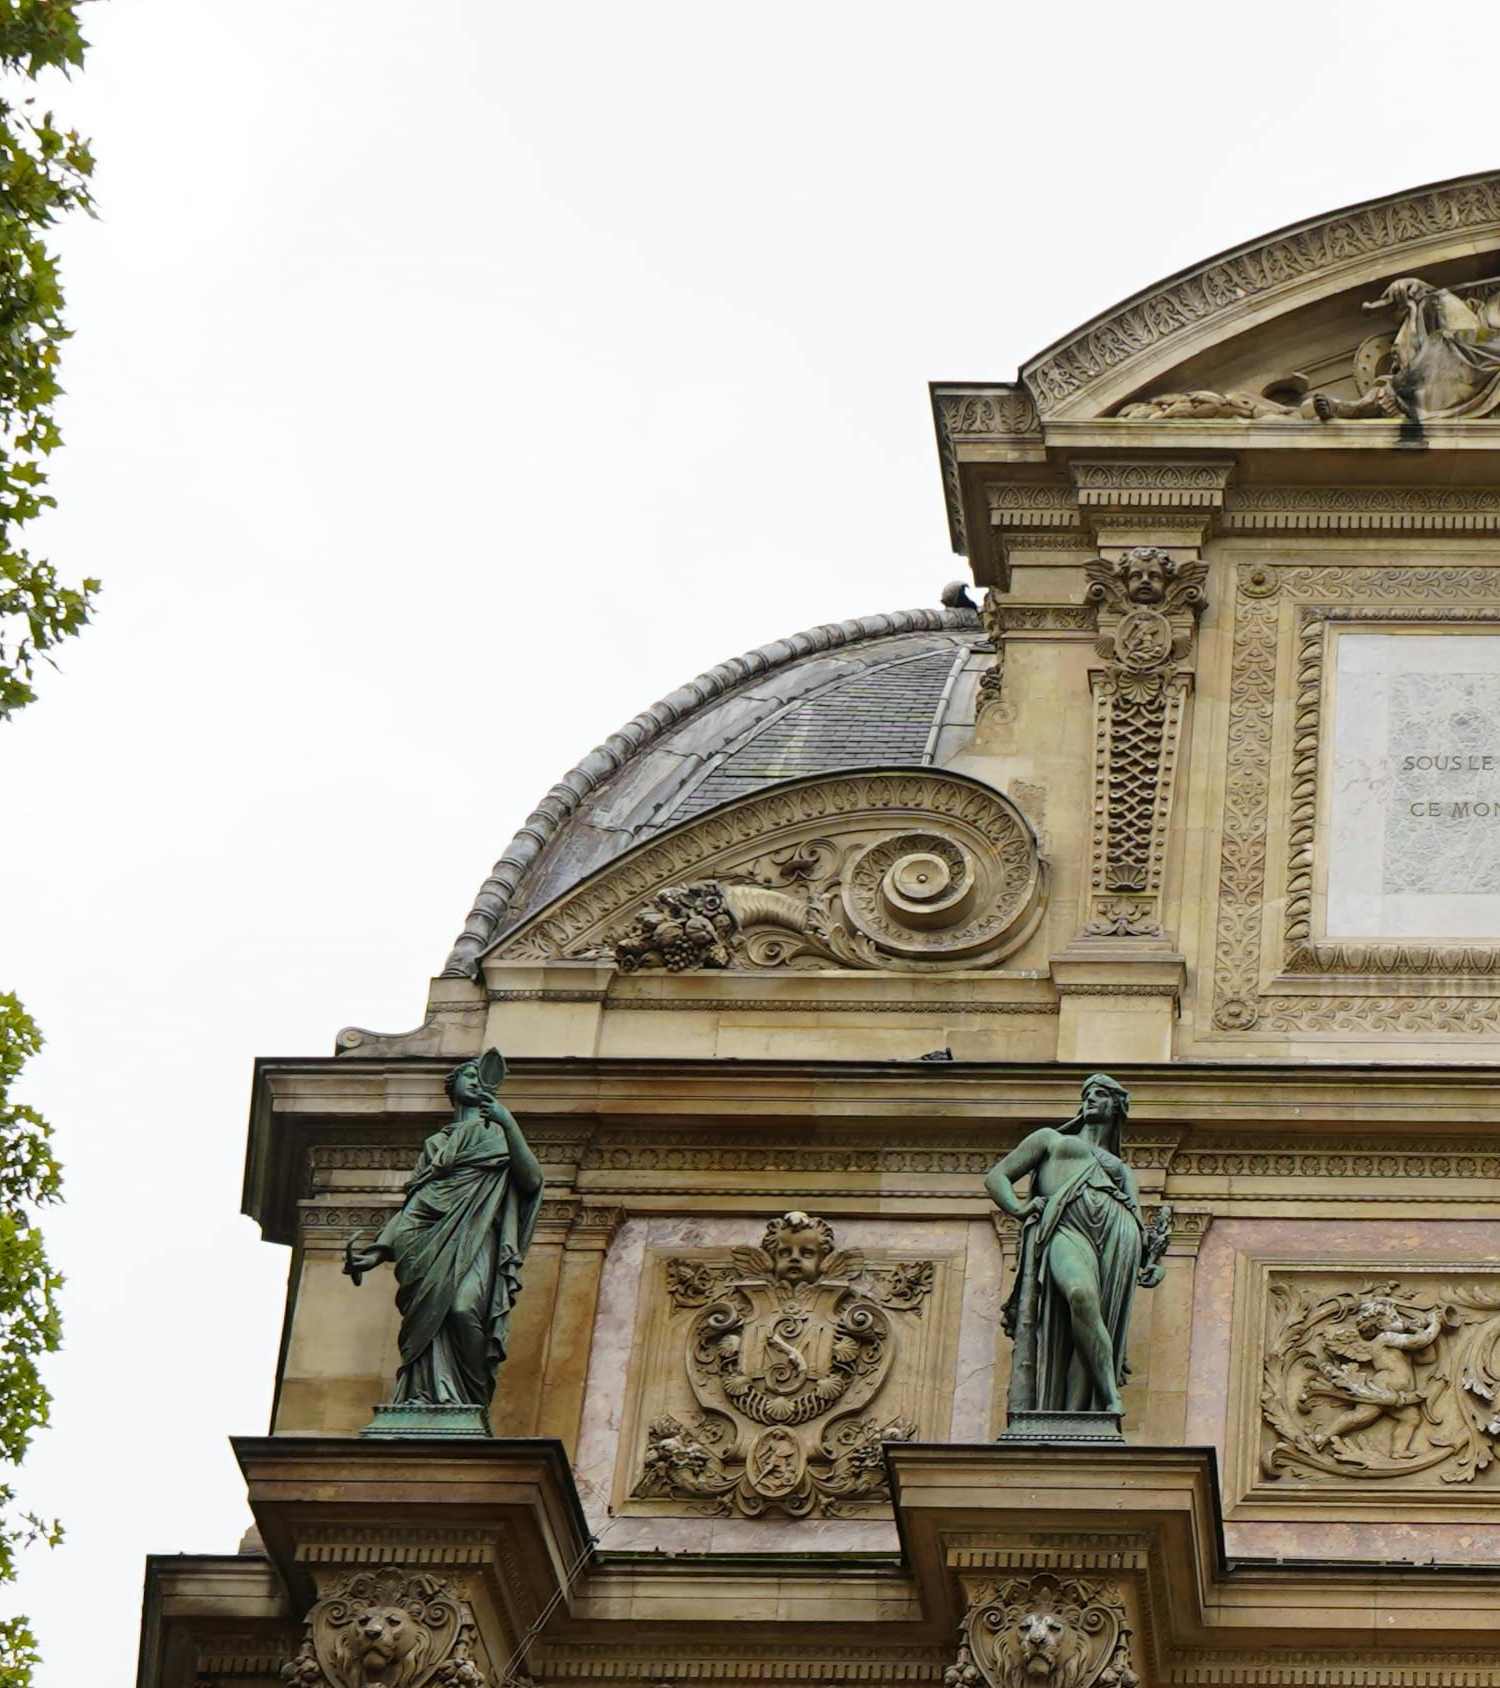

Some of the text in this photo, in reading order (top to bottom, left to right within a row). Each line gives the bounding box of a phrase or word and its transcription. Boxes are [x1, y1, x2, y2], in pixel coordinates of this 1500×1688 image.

[1402, 755, 1462, 771] SOUS
[1467, 755, 1494, 771] LE
[1410, 802, 1442, 817] CE
